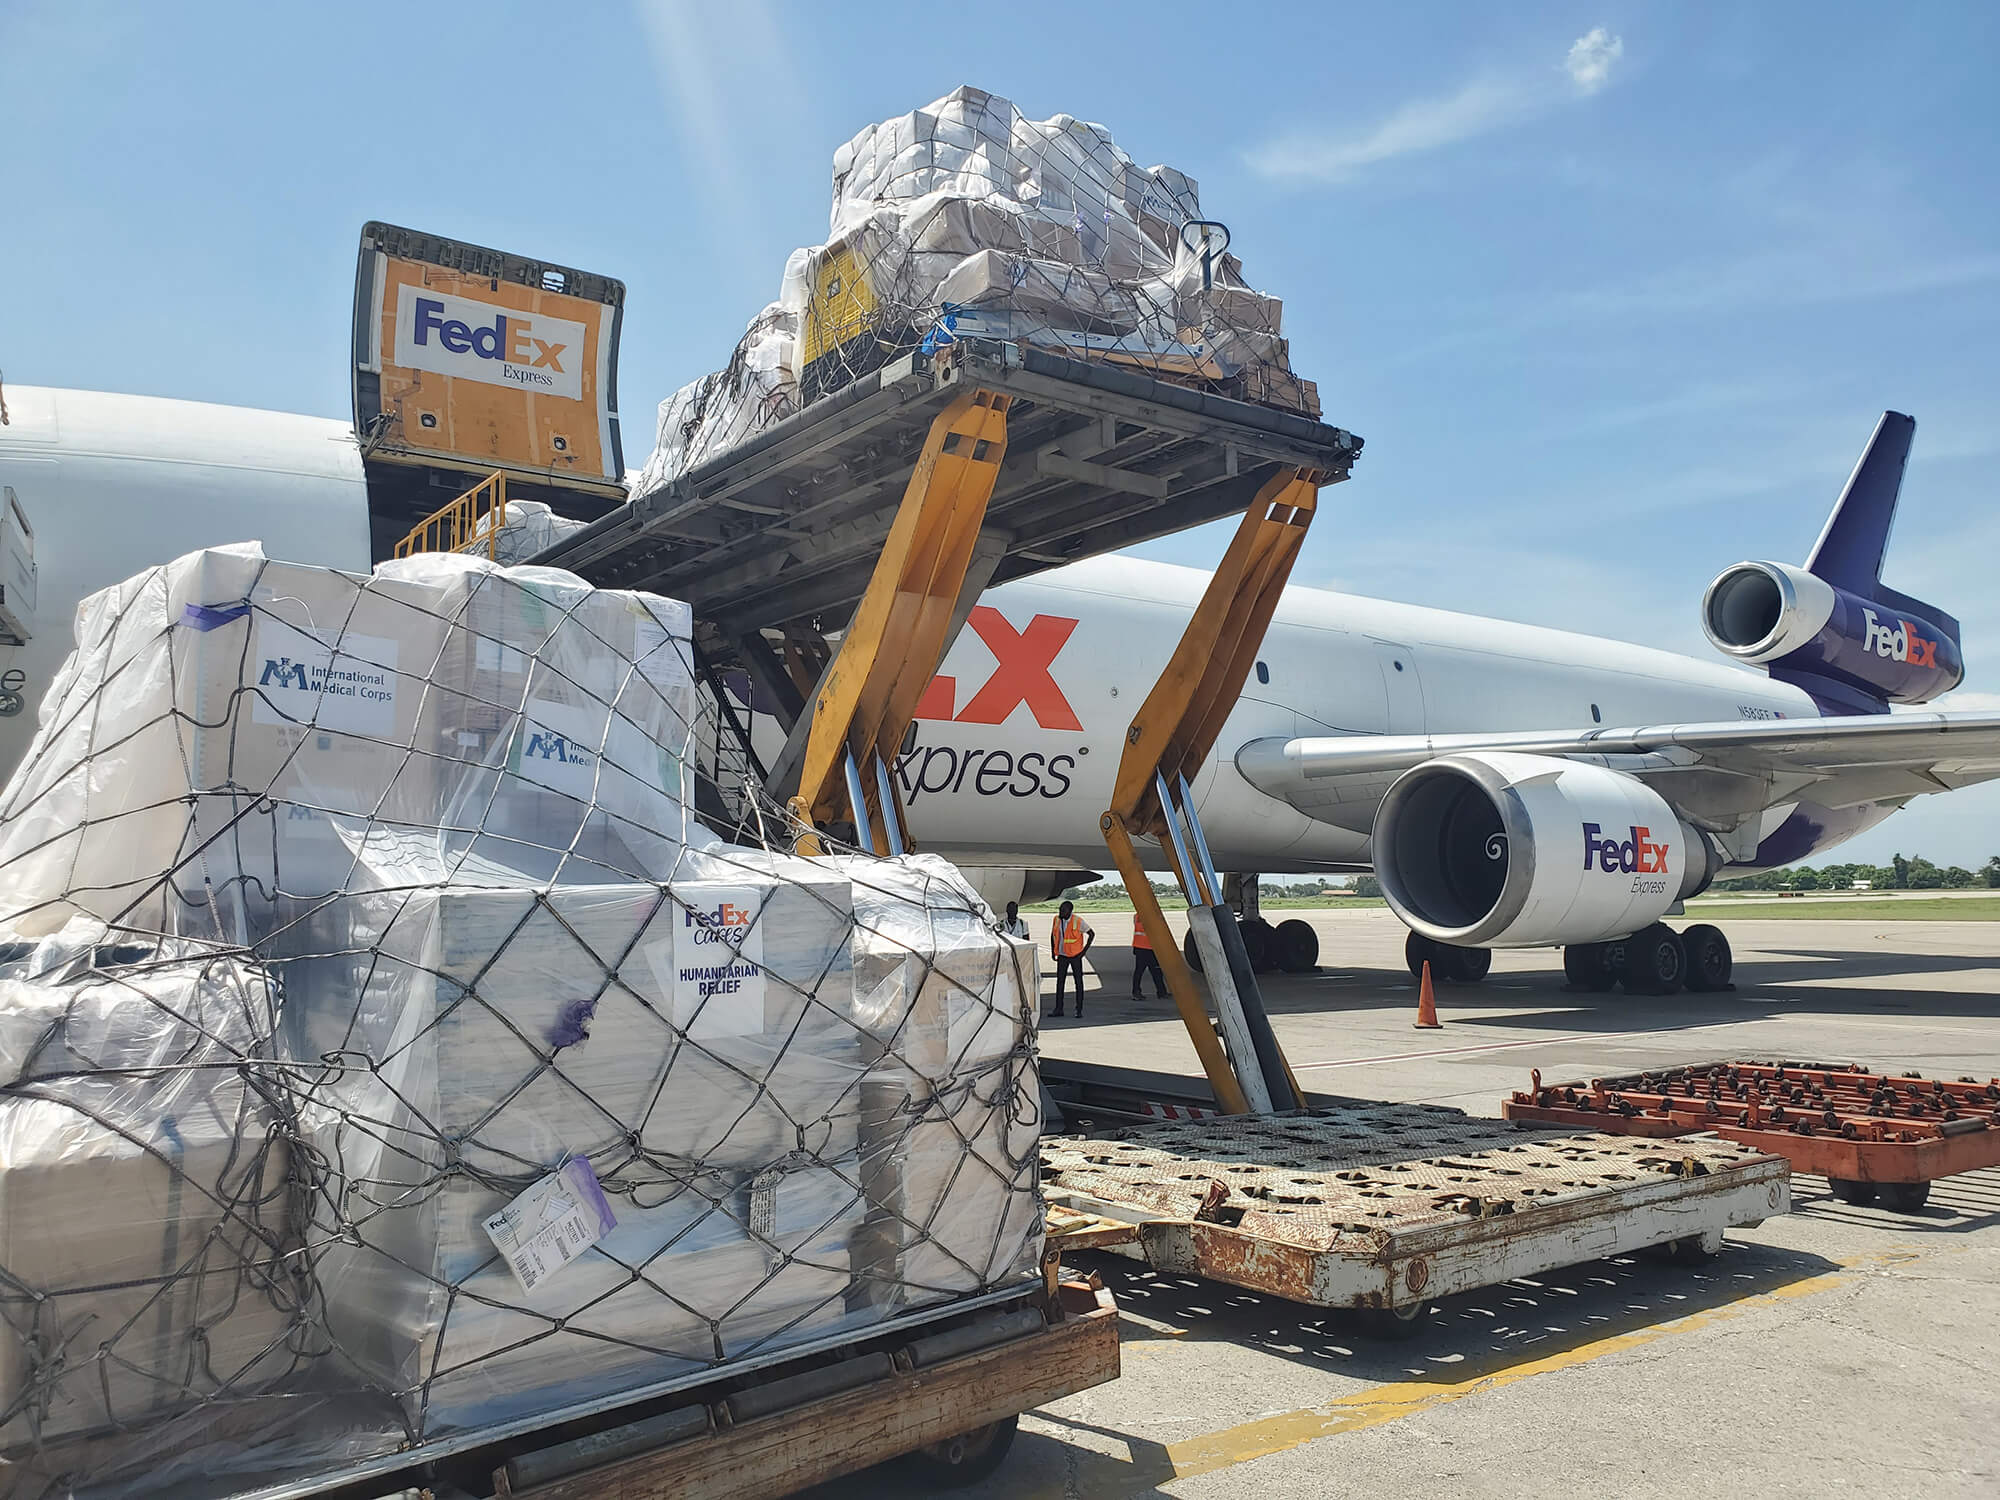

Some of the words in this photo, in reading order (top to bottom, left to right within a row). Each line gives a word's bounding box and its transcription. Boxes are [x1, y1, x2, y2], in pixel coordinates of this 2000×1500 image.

[414, 297, 567, 373] FedEx
[503, 364, 553, 386] Express
[1862, 607, 1937, 669] FedEx
[311, 666, 385, 685] International
[310, 680, 356, 696] Medical
[360, 687, 392, 702] Corps
[892, 746, 1075, 805] xpress
[1582, 822, 1669, 874] FedEx
[1631, 877, 1667, 896] Express
[685, 903, 750, 927] FedEx
[679, 965, 759, 982] HUMANITARIAN
[699, 980, 741, 996] RELIEF
